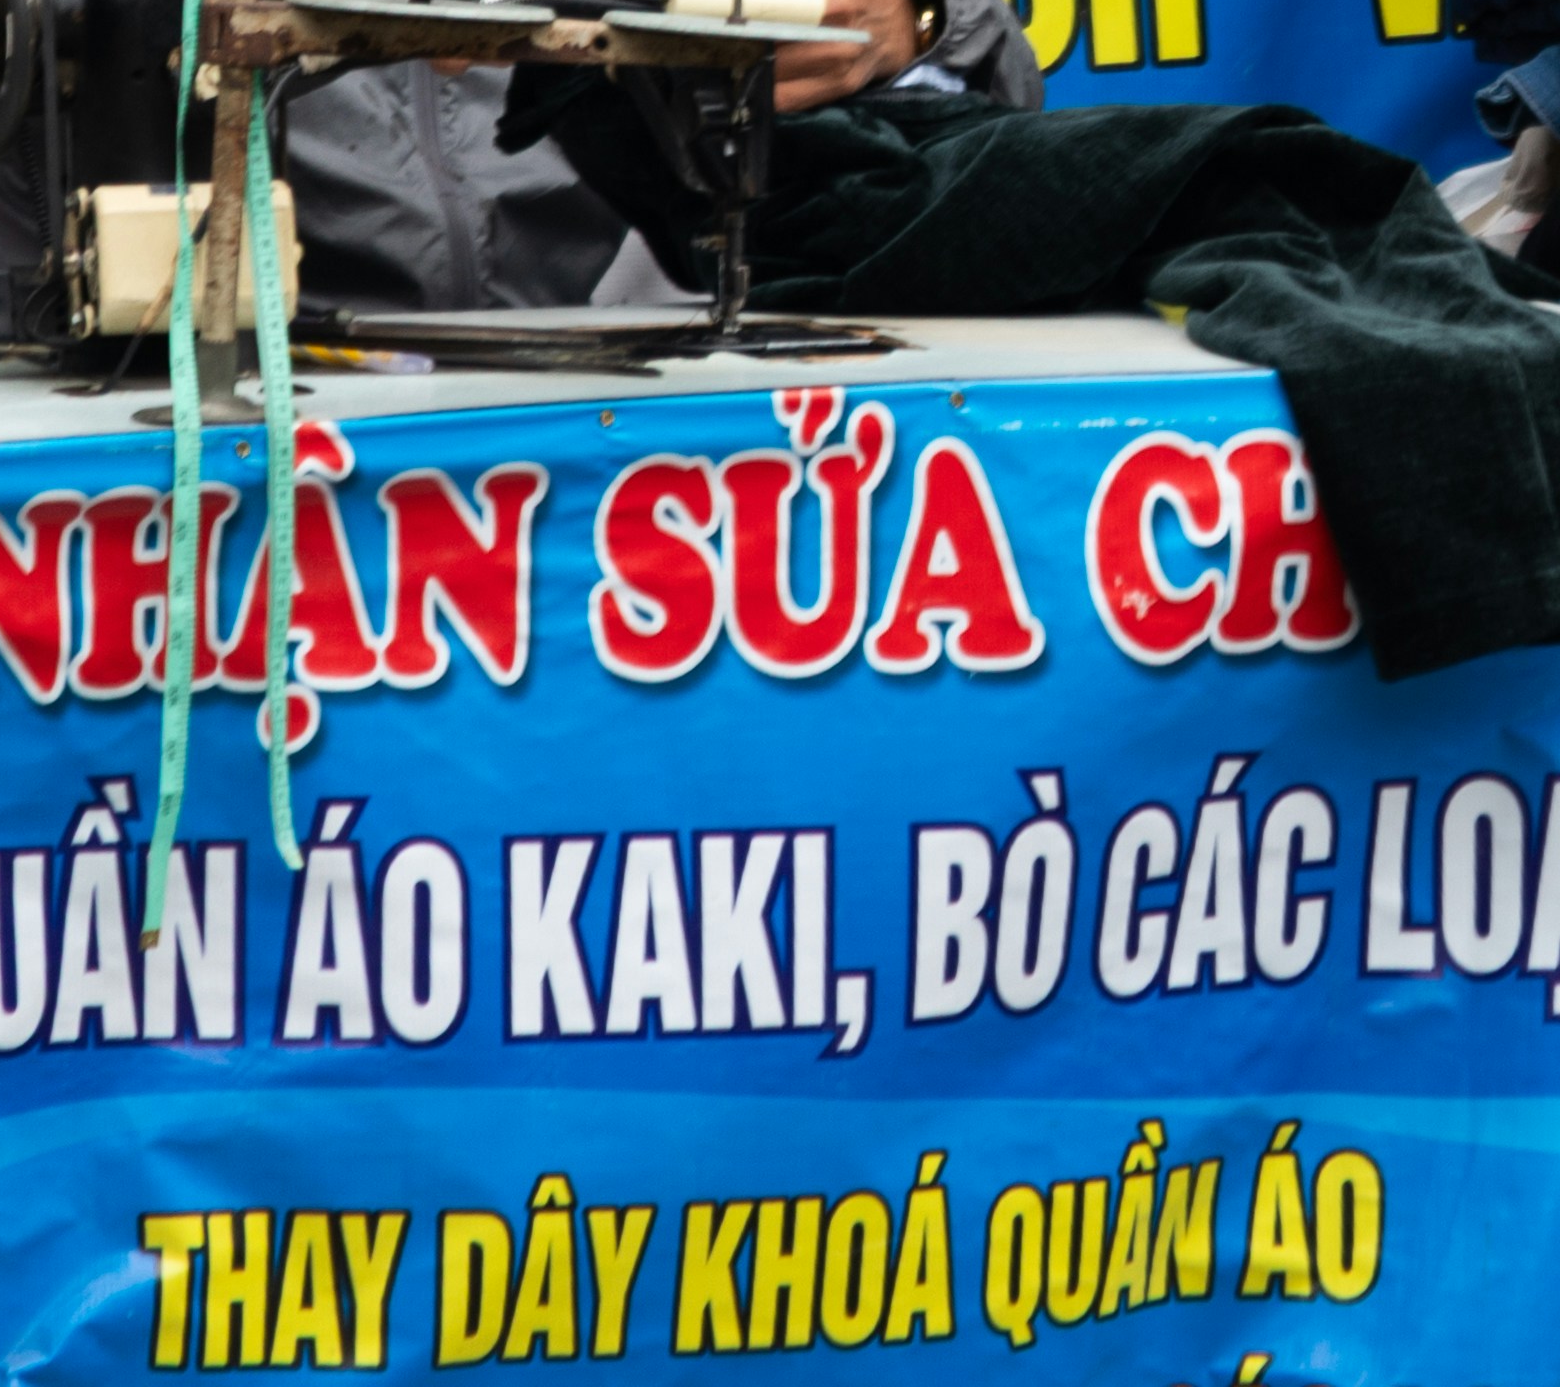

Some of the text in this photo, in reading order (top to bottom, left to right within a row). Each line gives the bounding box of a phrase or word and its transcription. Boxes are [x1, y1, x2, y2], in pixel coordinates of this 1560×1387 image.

[589, 389, 1045, 682] SỬA
[276, 799, 466, 1044] ÁO
[506, 831, 870, 1055] KAKI,
[910, 771, 1076, 1023] BÒ
[1096, 756, 1333, 996] CÁC
[143, 1120, 1382, 1369] THAY DÂY KHOÁ QUẦN ÁO
